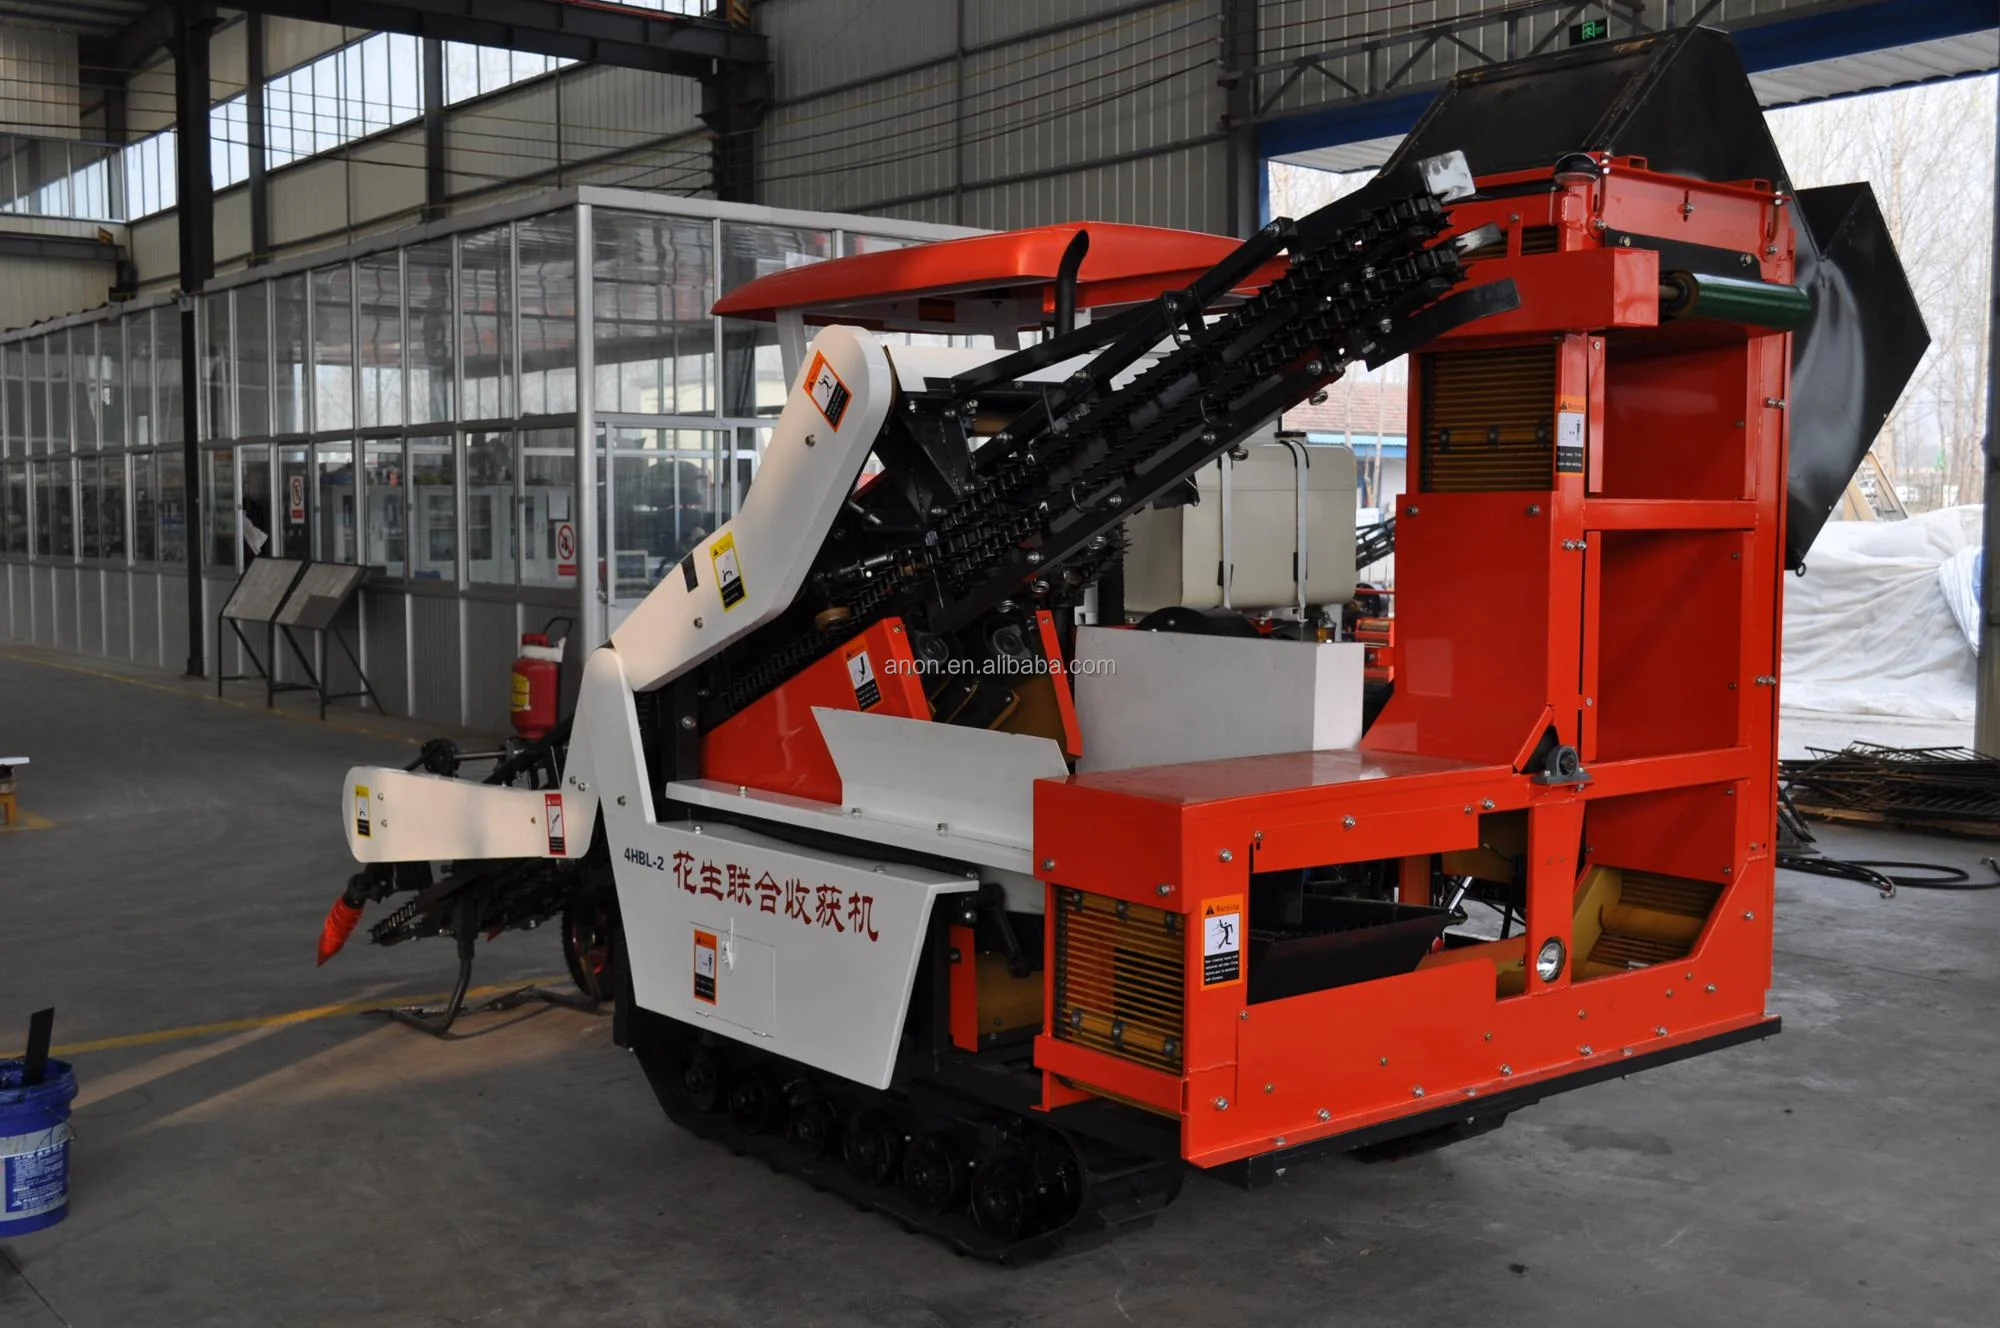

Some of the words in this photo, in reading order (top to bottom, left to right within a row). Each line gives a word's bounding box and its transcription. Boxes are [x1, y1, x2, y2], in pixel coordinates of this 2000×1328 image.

[624, 848, 665, 871] 4HBL-2
[672, 849, 879, 942] 花生联合收获机
